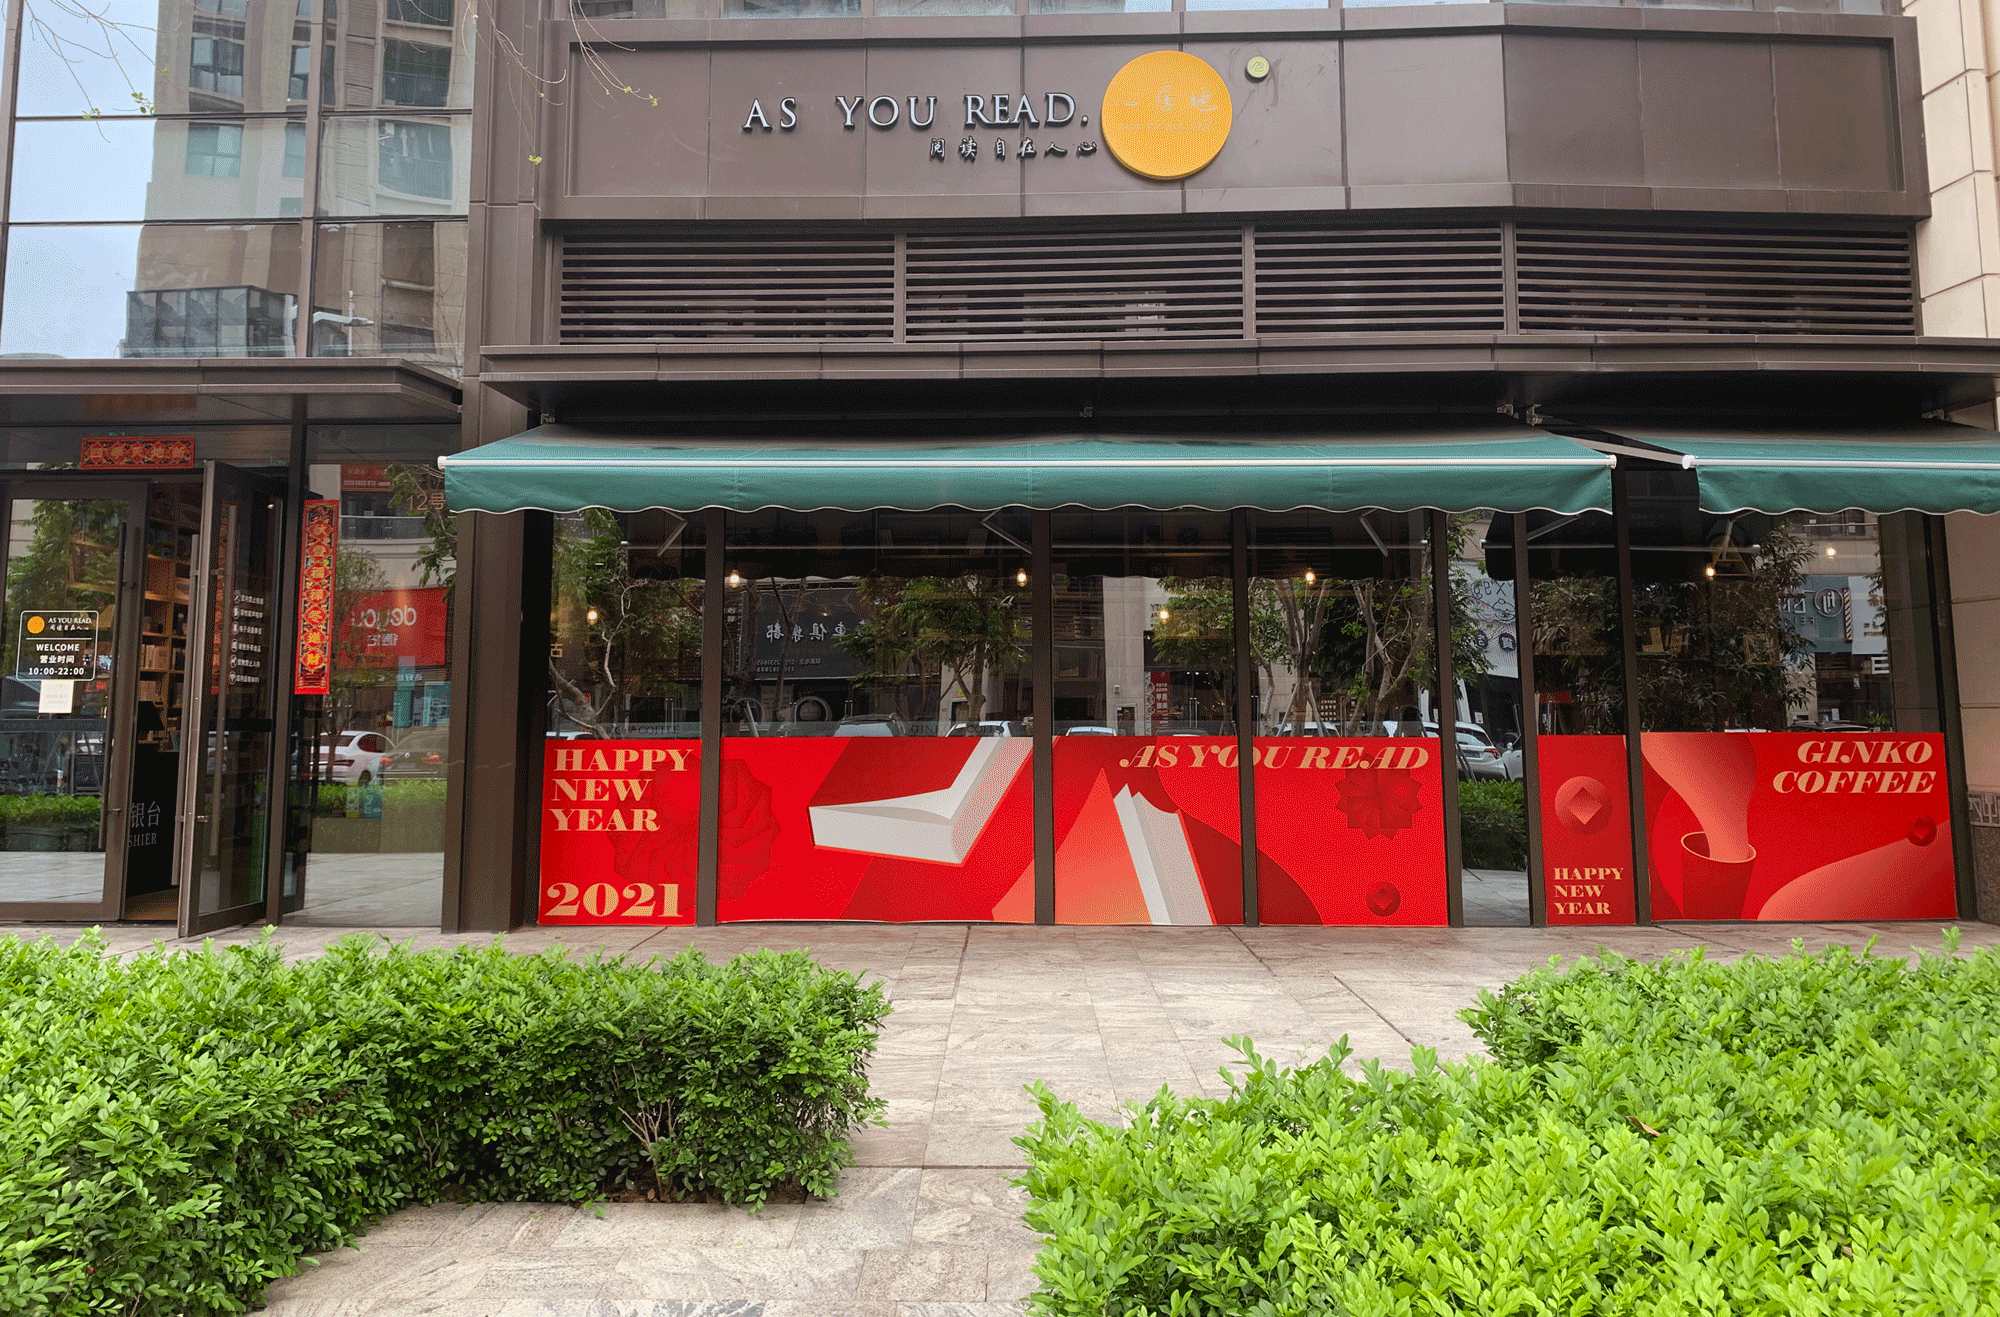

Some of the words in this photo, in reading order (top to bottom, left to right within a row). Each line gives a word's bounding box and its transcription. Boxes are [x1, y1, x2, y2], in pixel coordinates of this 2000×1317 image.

[742, 98, 797, 131] AS
[837, 96, 937, 130] YOU
[964, 93, 1089, 128] READ.
[930, 137, 1098, 162] 阅读自在人心
[36, 643, 80, 652] WELCOME
[40, 655, 75, 664] 营业时间
[28, 667, 85, 675] 10:00-22:00
[553, 748, 694, 772] HAPPY
[1119, 744, 1181, 769] AS
[1187, 744, 1296, 769] YOU
[1297, 745, 1430, 770] READ
[1796, 740, 1934, 765] GINKO
[551, 778, 653, 802] NEW
[1772, 770, 1937, 795] COFFEE
[549, 808, 661, 832] YEAR
[1553, 866, 1625, 881] HAPPY
[544, 882, 684, 918] 2021
[1554, 884, 1605, 899] NEW
[1554, 902, 1612, 916] YEAR
